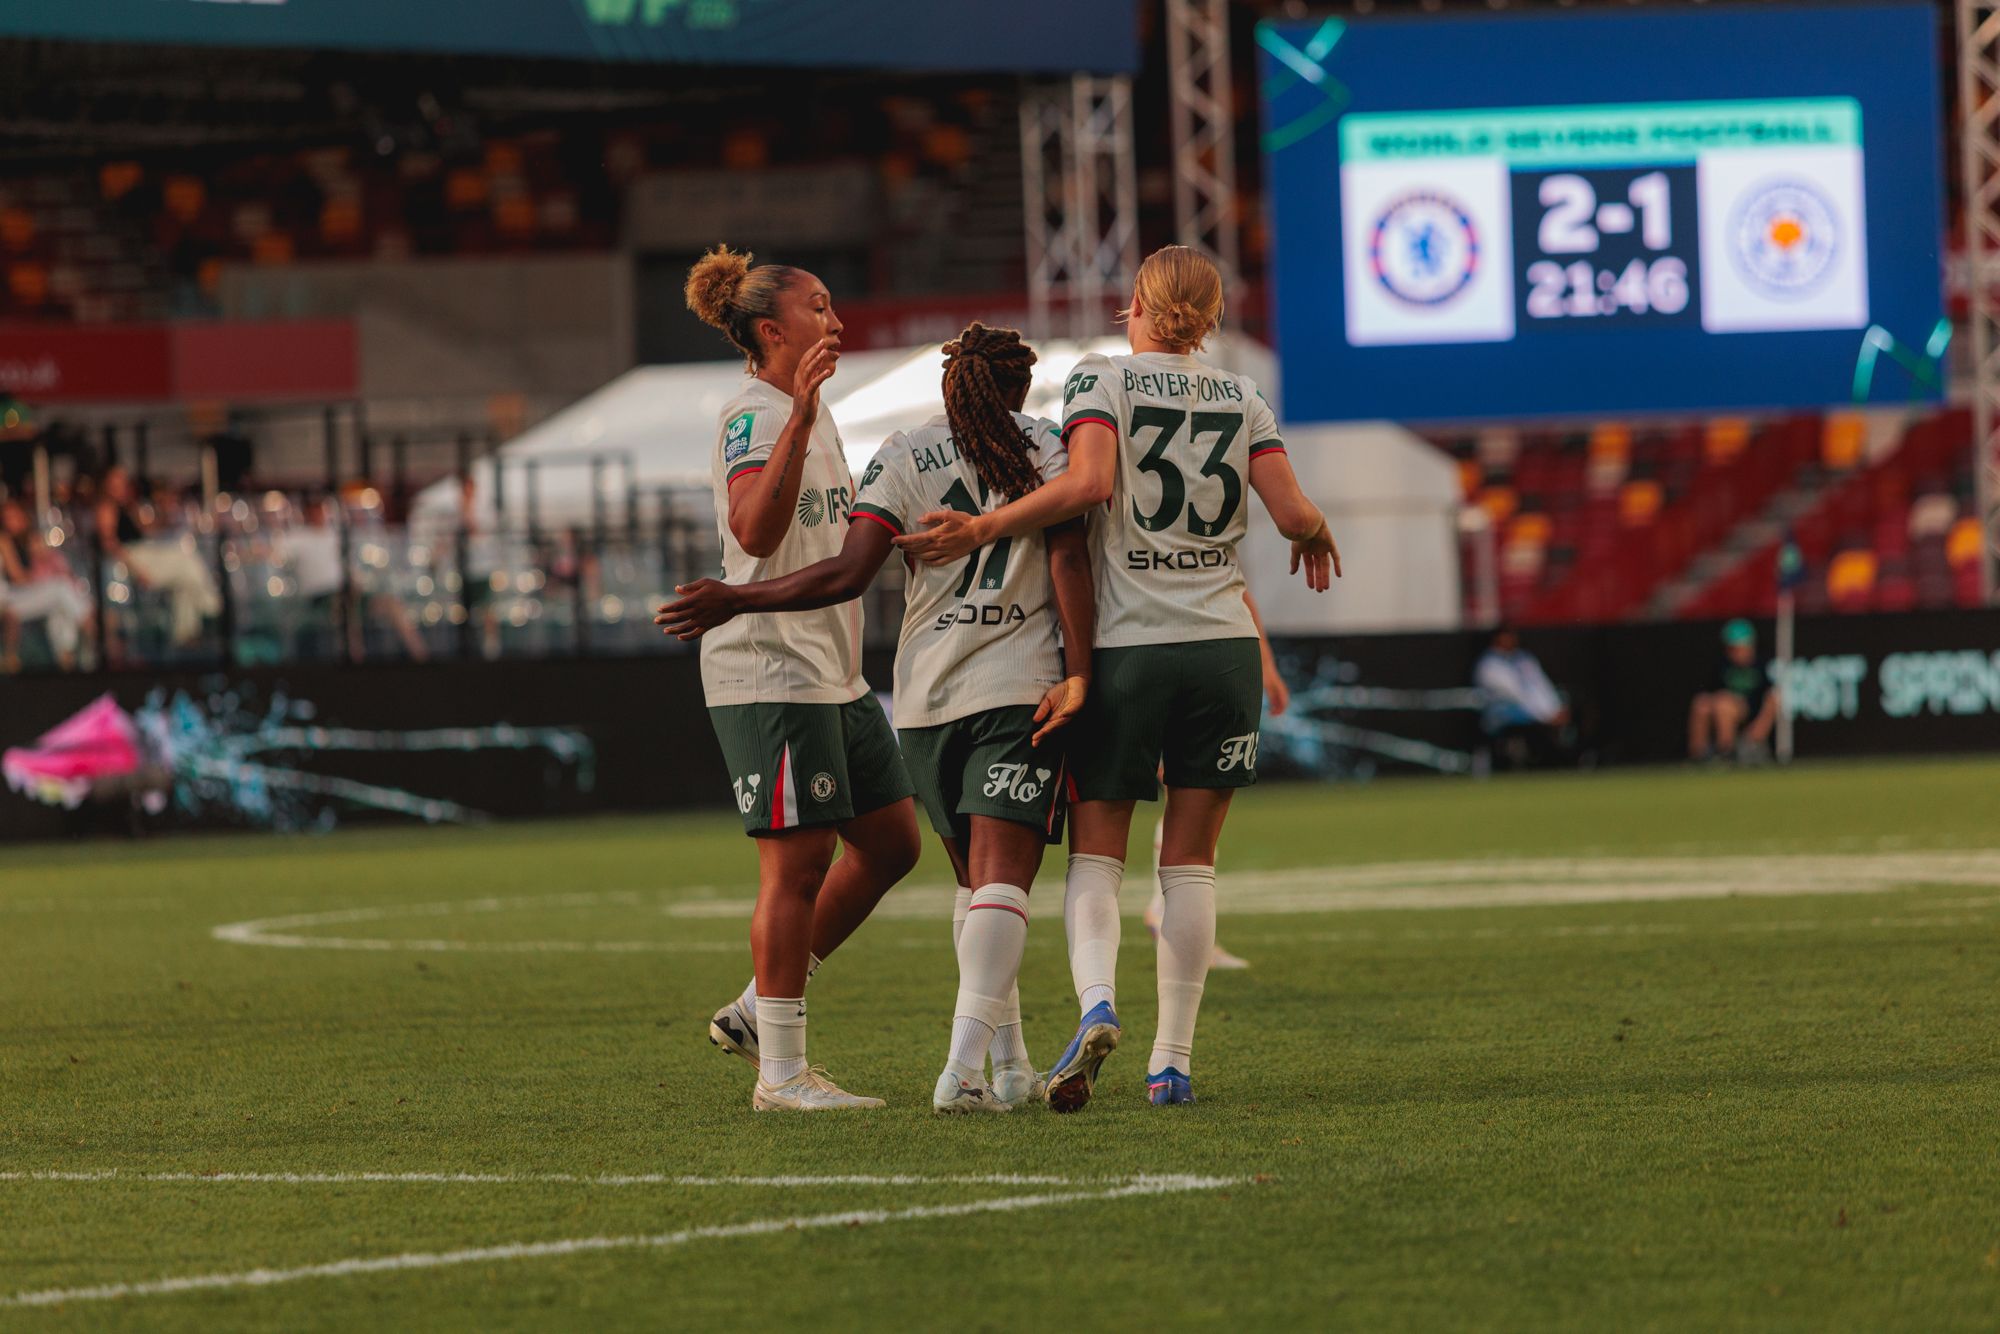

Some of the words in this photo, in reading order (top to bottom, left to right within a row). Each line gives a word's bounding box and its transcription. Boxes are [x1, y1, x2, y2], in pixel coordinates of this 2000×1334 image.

[1537, 171, 1672, 254] 2-1
[1526, 256, 1689, 319] 21:46
[1123, 368, 1243, 402] BEEVER-JONES
[1129, 405, 1244, 537] 33
[826, 486, 849, 524] IFS
[984, 763, 1042, 802] Flo
